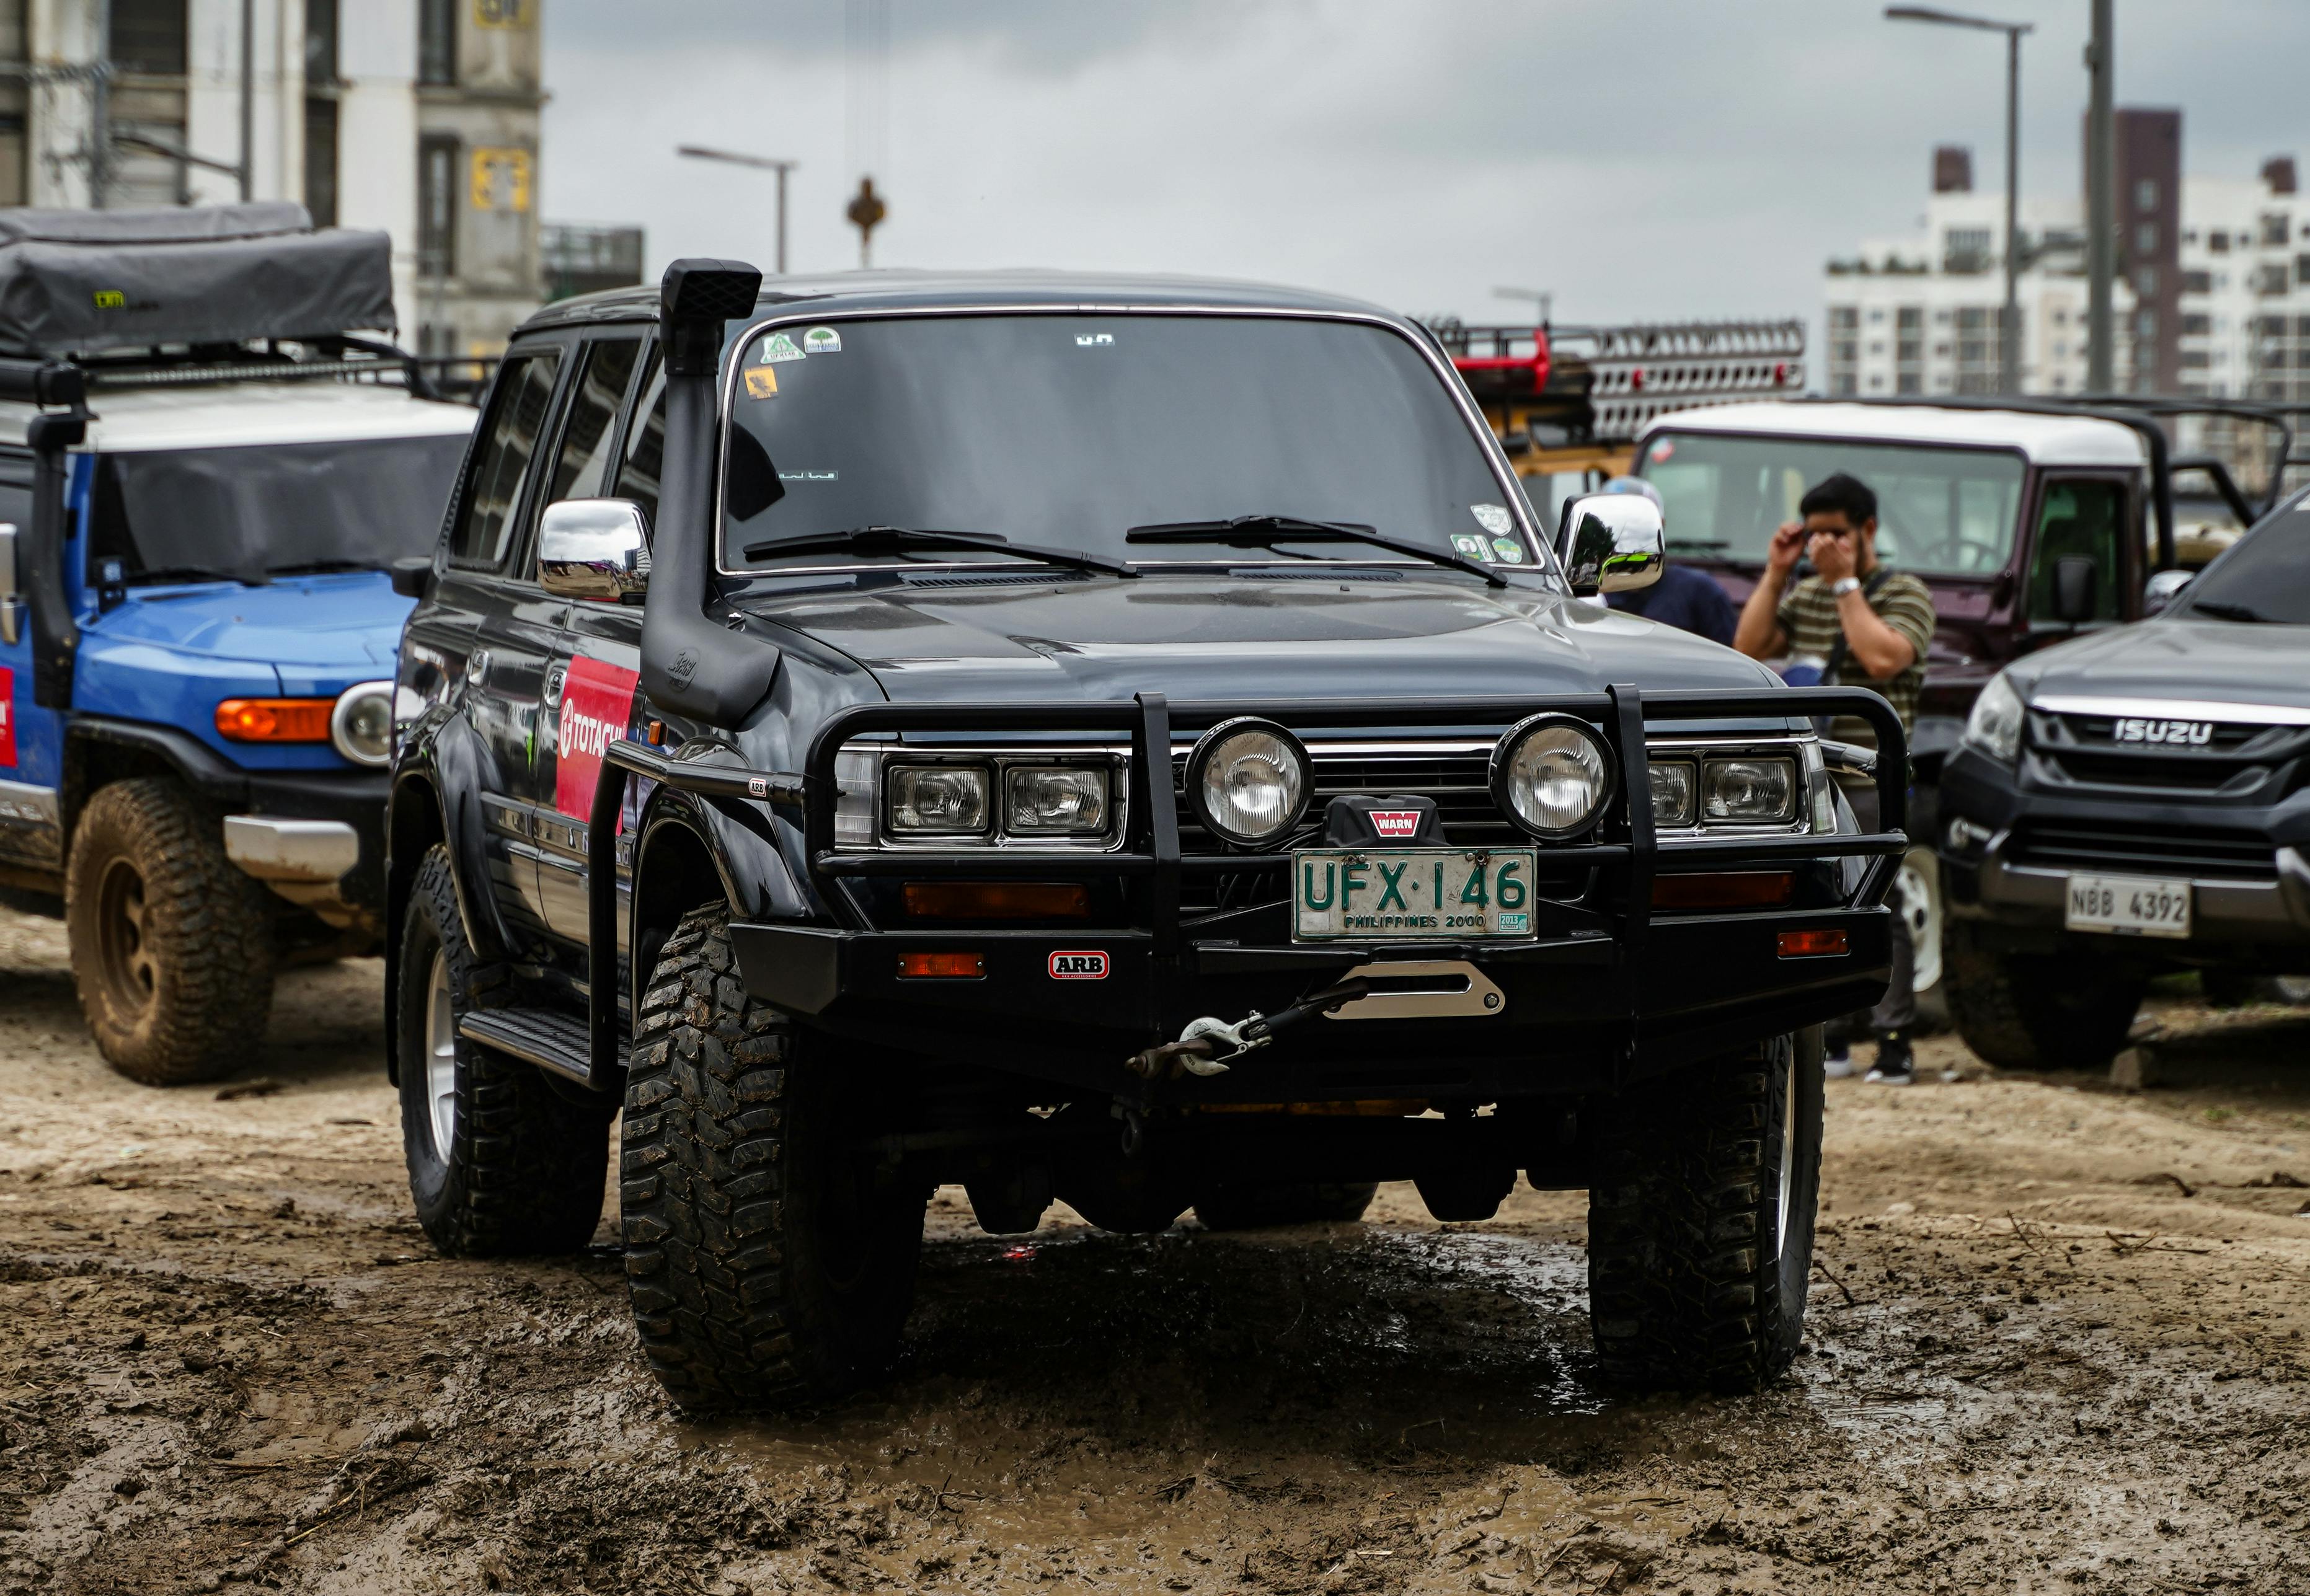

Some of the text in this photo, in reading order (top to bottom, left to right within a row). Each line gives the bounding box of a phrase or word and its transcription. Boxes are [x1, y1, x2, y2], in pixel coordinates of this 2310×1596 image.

[2115, 718, 2213, 744] ISUZU
[751, 782, 764, 793] ARB
[1378, 819, 1413, 829] WARN
[2130, 891, 2186, 923] 4392
[1343, 914, 1487, 928] PHILIPPINES 2000
[1501, 915, 1518, 925] 2013
[1056, 957, 1103, 973] ARB
